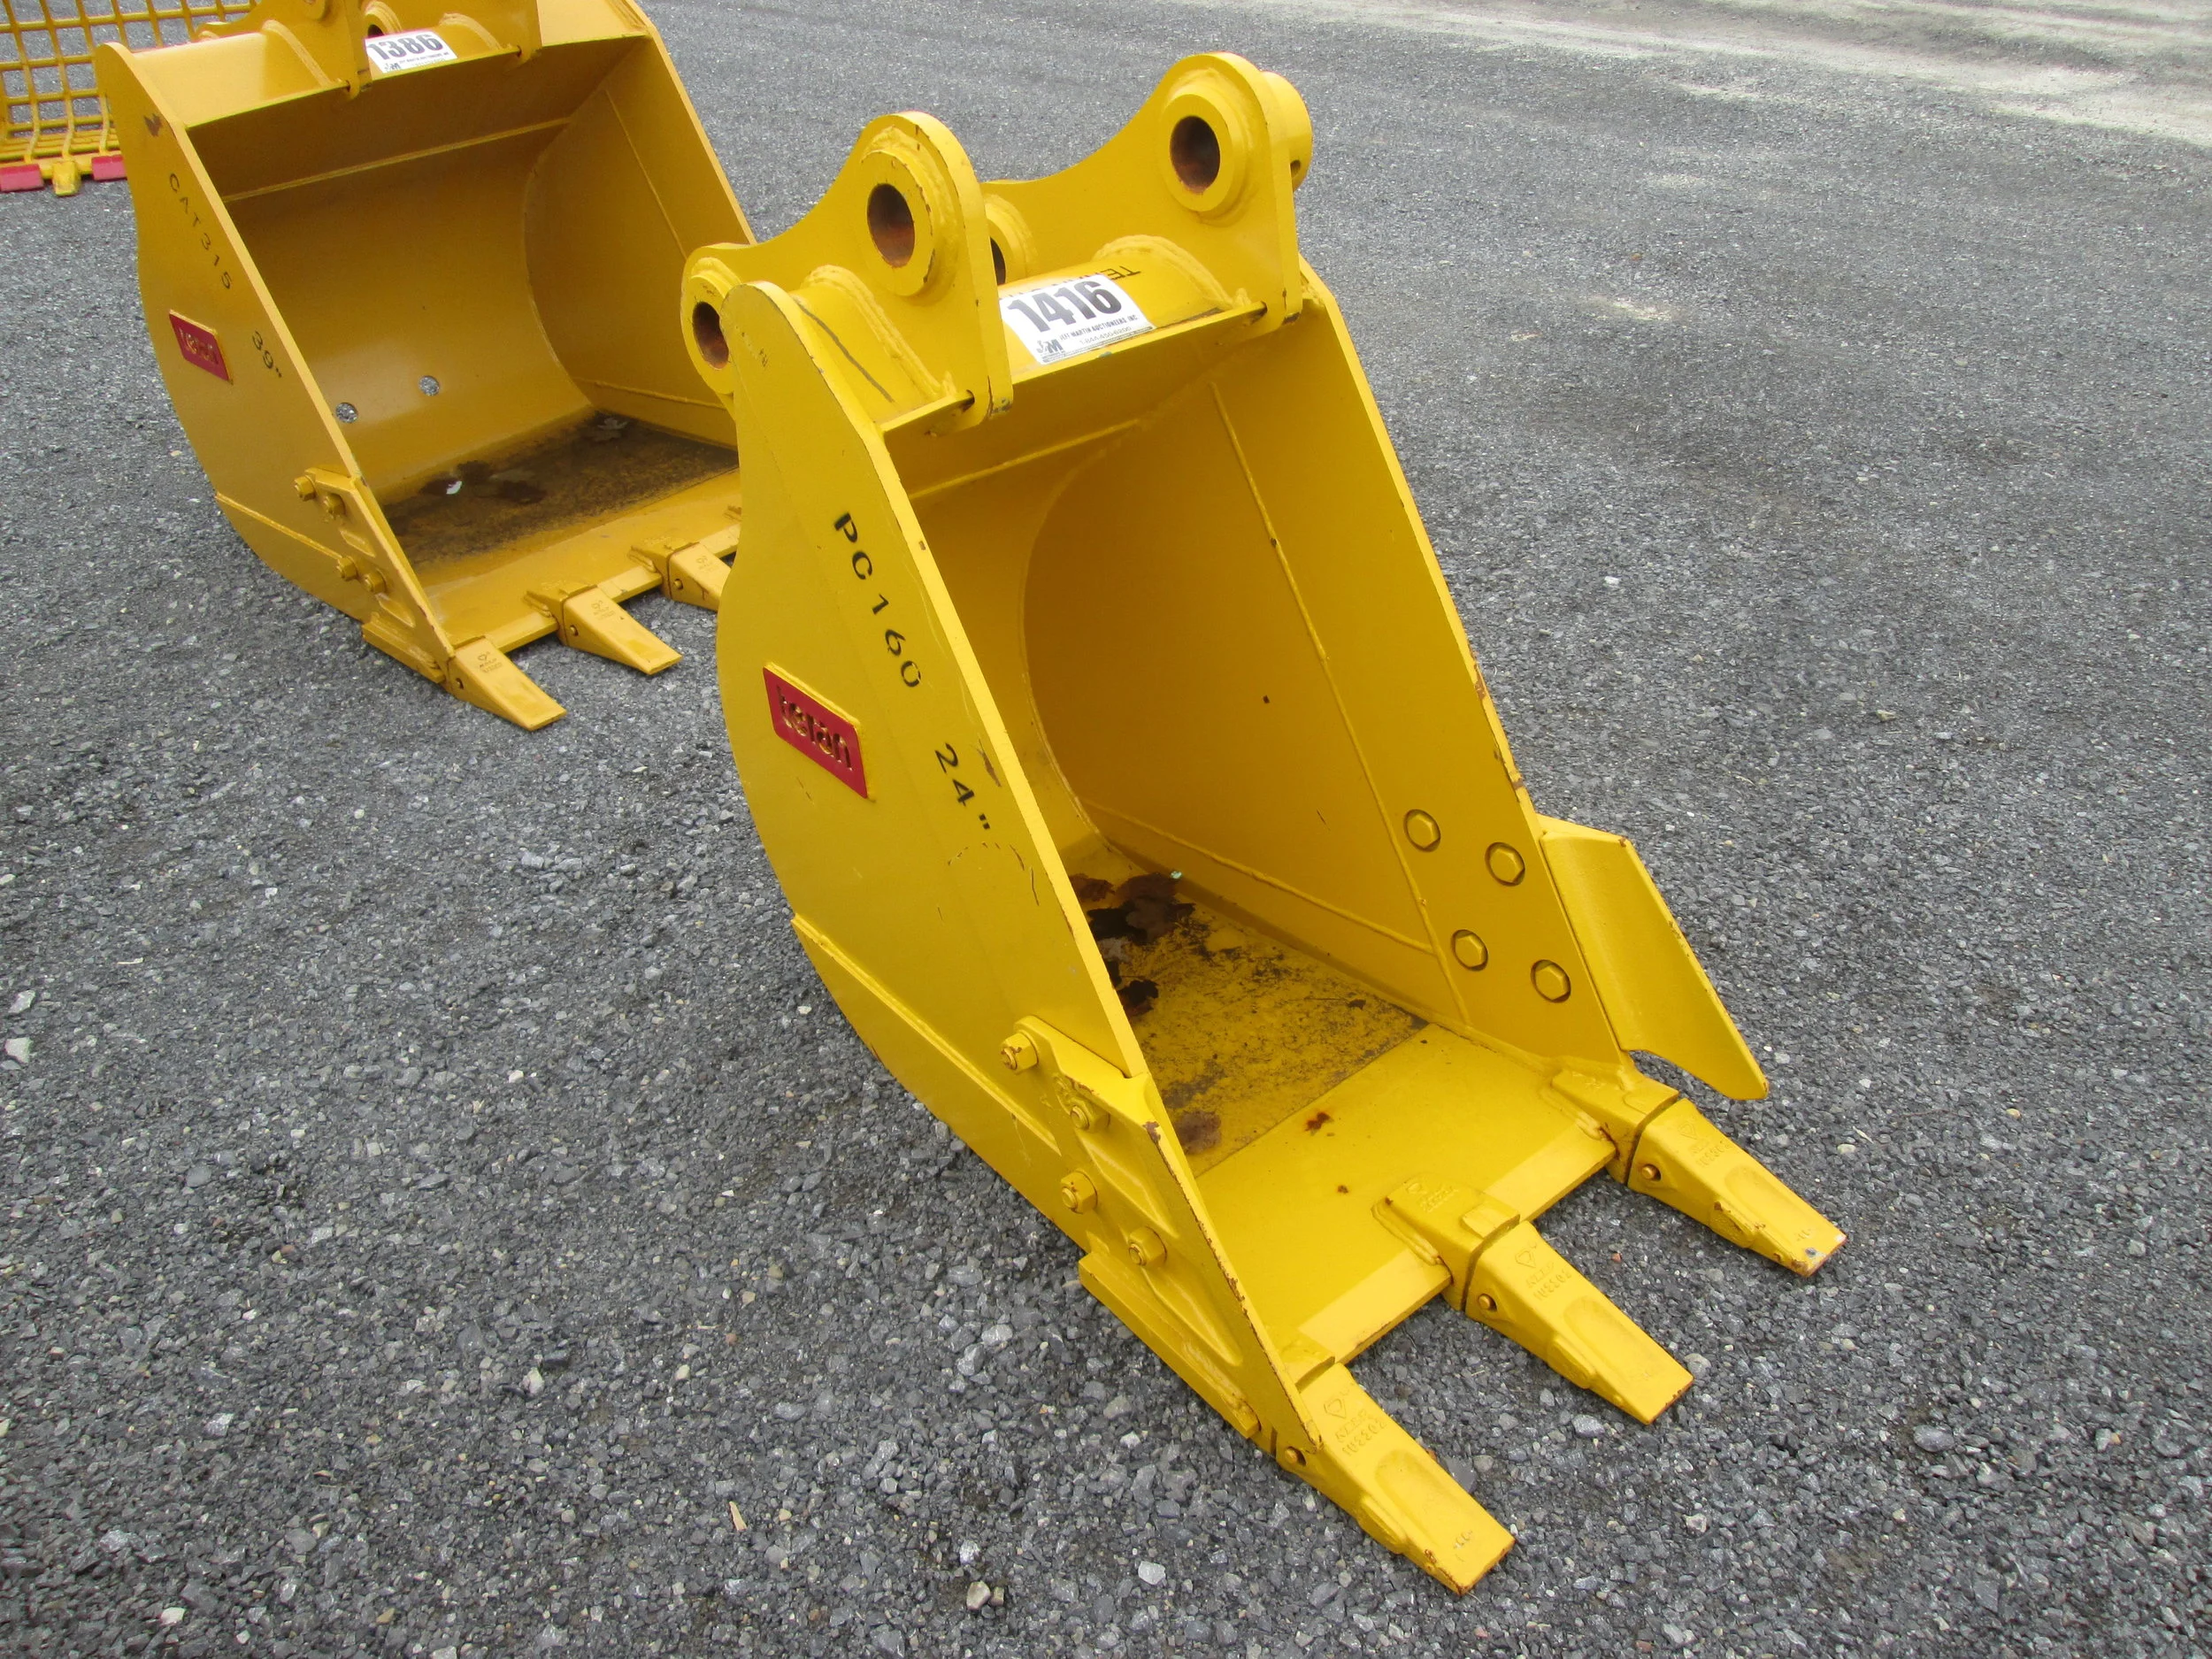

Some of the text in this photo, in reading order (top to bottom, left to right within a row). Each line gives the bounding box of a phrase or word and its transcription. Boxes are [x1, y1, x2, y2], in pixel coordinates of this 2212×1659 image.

[368, 35, 443, 60] 1386
[1007, 280, 1122, 333] 1416
[1071, 327, 1092, 337] MARTIN
[776, 685, 854, 772] teran
